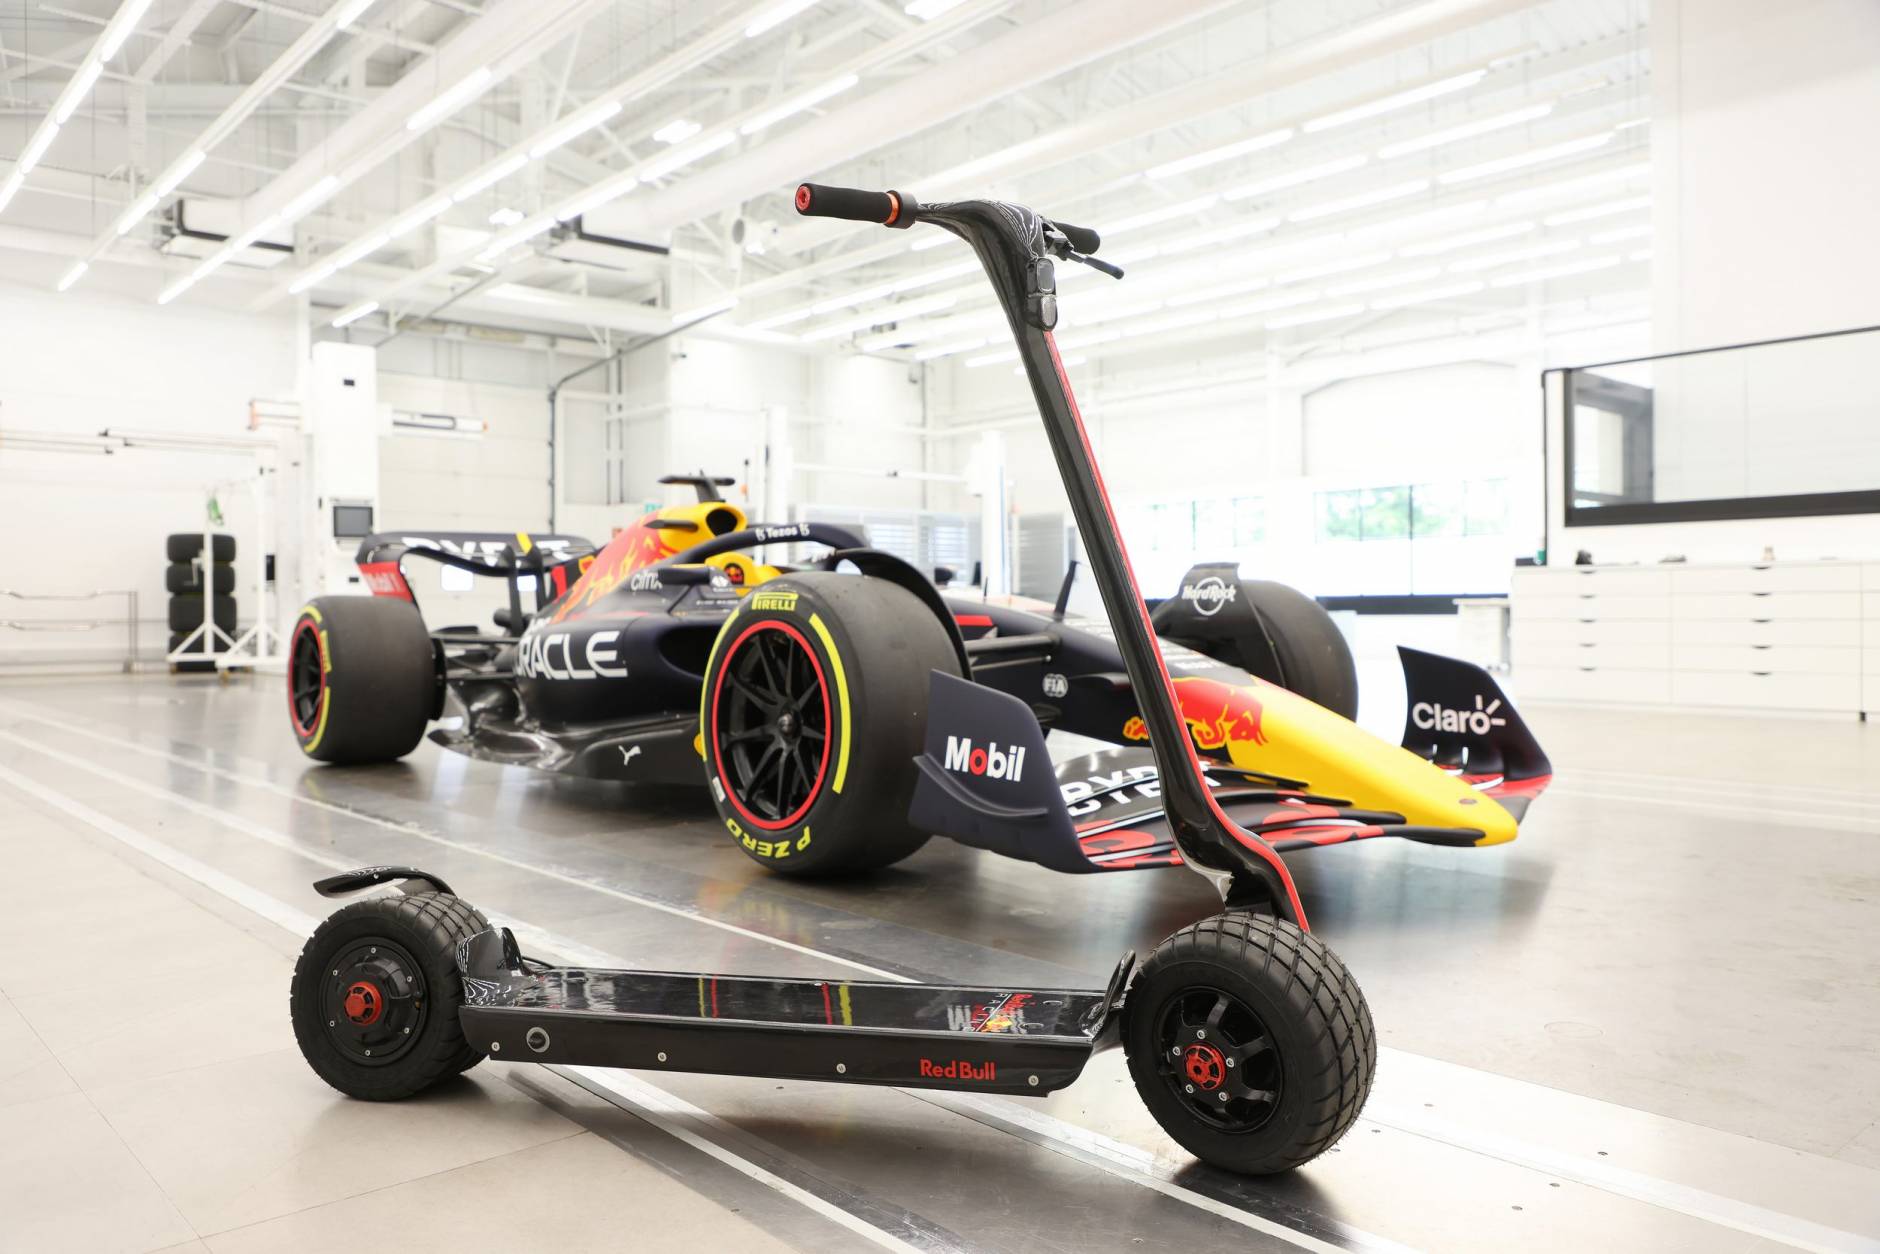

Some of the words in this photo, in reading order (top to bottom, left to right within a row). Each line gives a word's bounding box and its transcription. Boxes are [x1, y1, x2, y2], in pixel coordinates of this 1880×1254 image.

[766, 526, 798, 538] Tezos
[752, 591, 799, 612] PIRELLI
[1412, 702, 1491, 735] Claro
[944, 735, 1026, 782] Mobil
[726, 818, 791, 858] ZERO
[796, 825, 812, 851] P
[920, 1059, 957, 1078] Red
[960, 1061, 996, 1081] Bull
